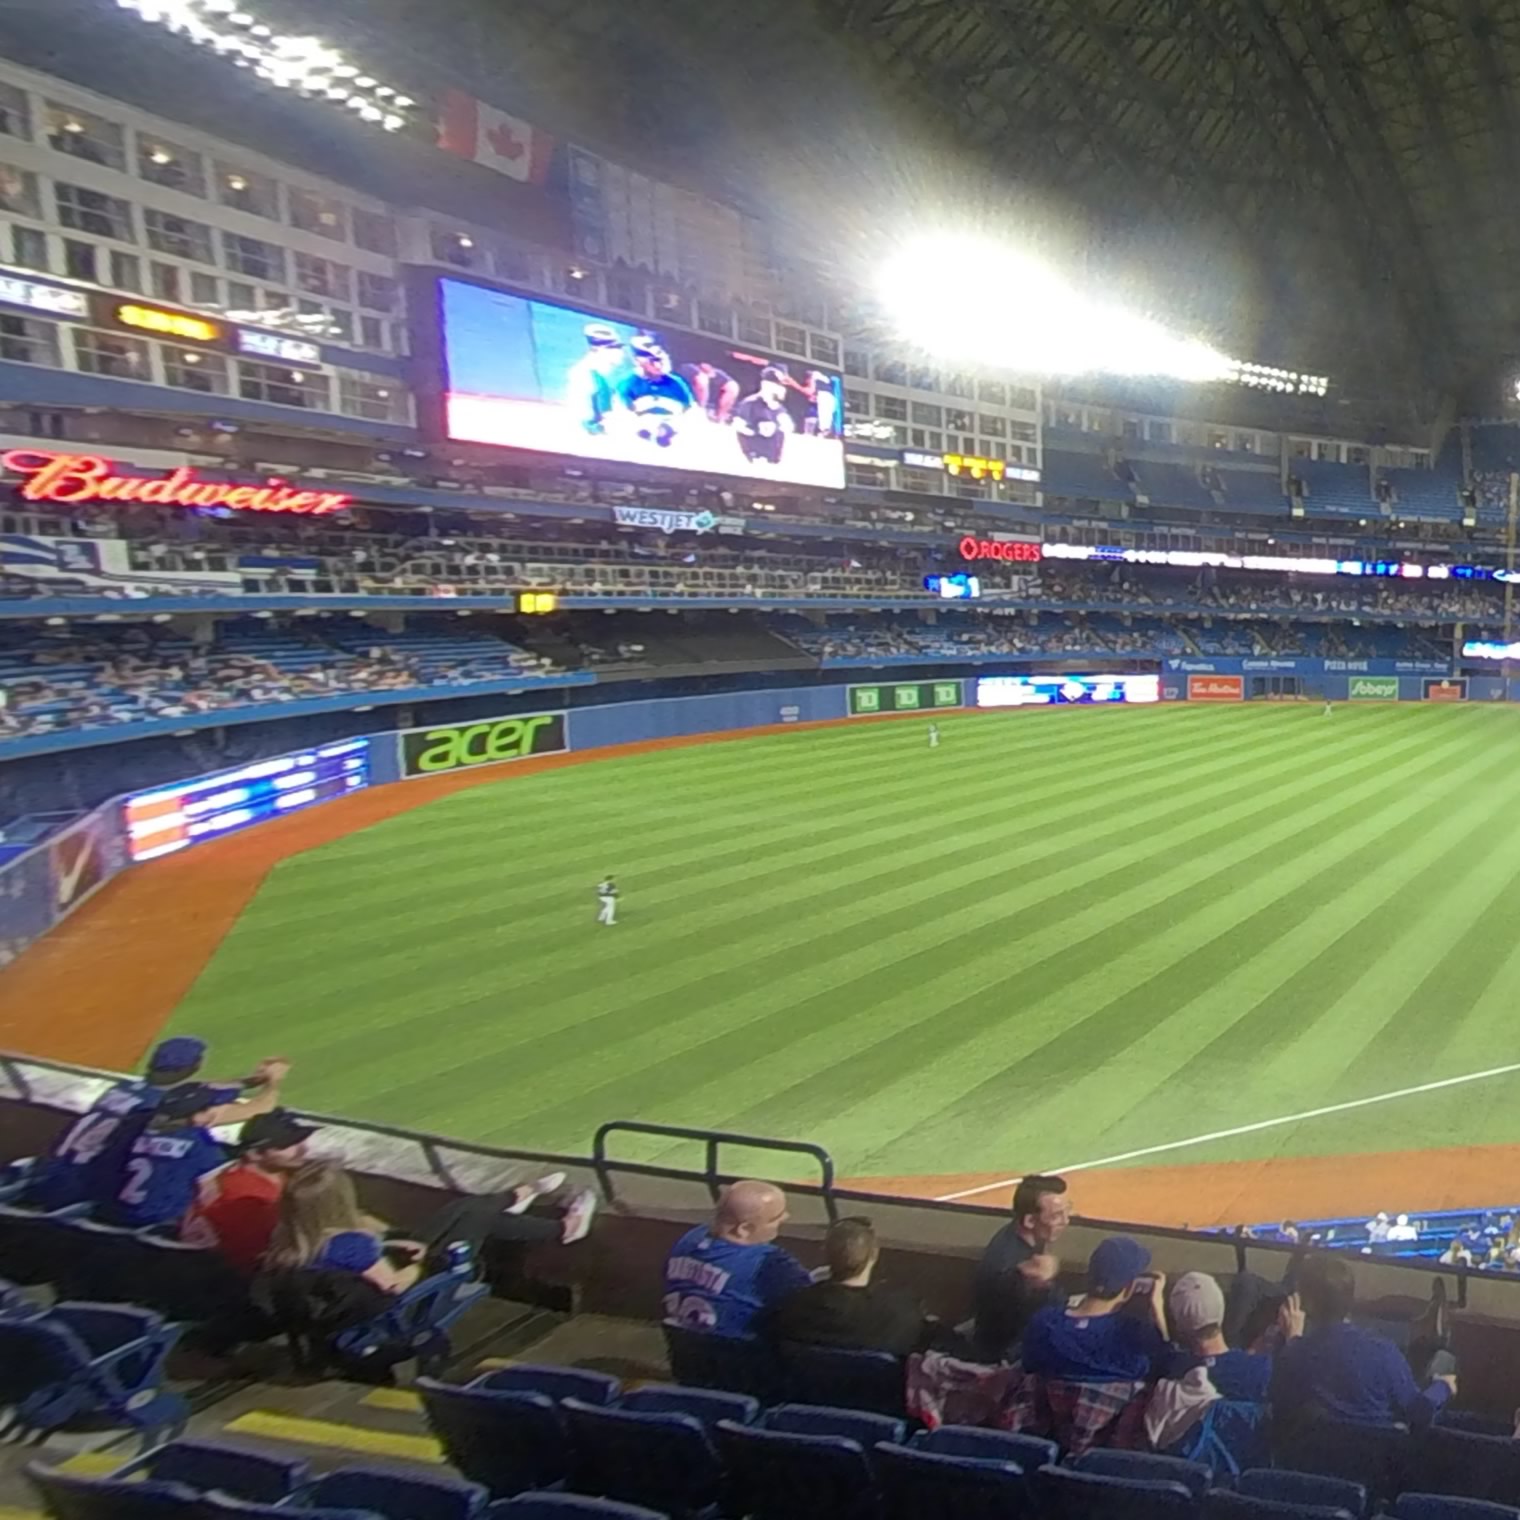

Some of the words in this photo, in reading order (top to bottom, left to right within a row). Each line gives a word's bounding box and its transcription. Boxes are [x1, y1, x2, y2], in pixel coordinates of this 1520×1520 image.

[2, 450, 352, 513] Budweiser
[617, 509, 694, 530] WESTJET
[977, 541, 1041, 562] ROGERS
[1351, 680, 1397, 697] Sobeys
[418, 714, 553, 772] acer
[118, 1157, 153, 1204] 2
